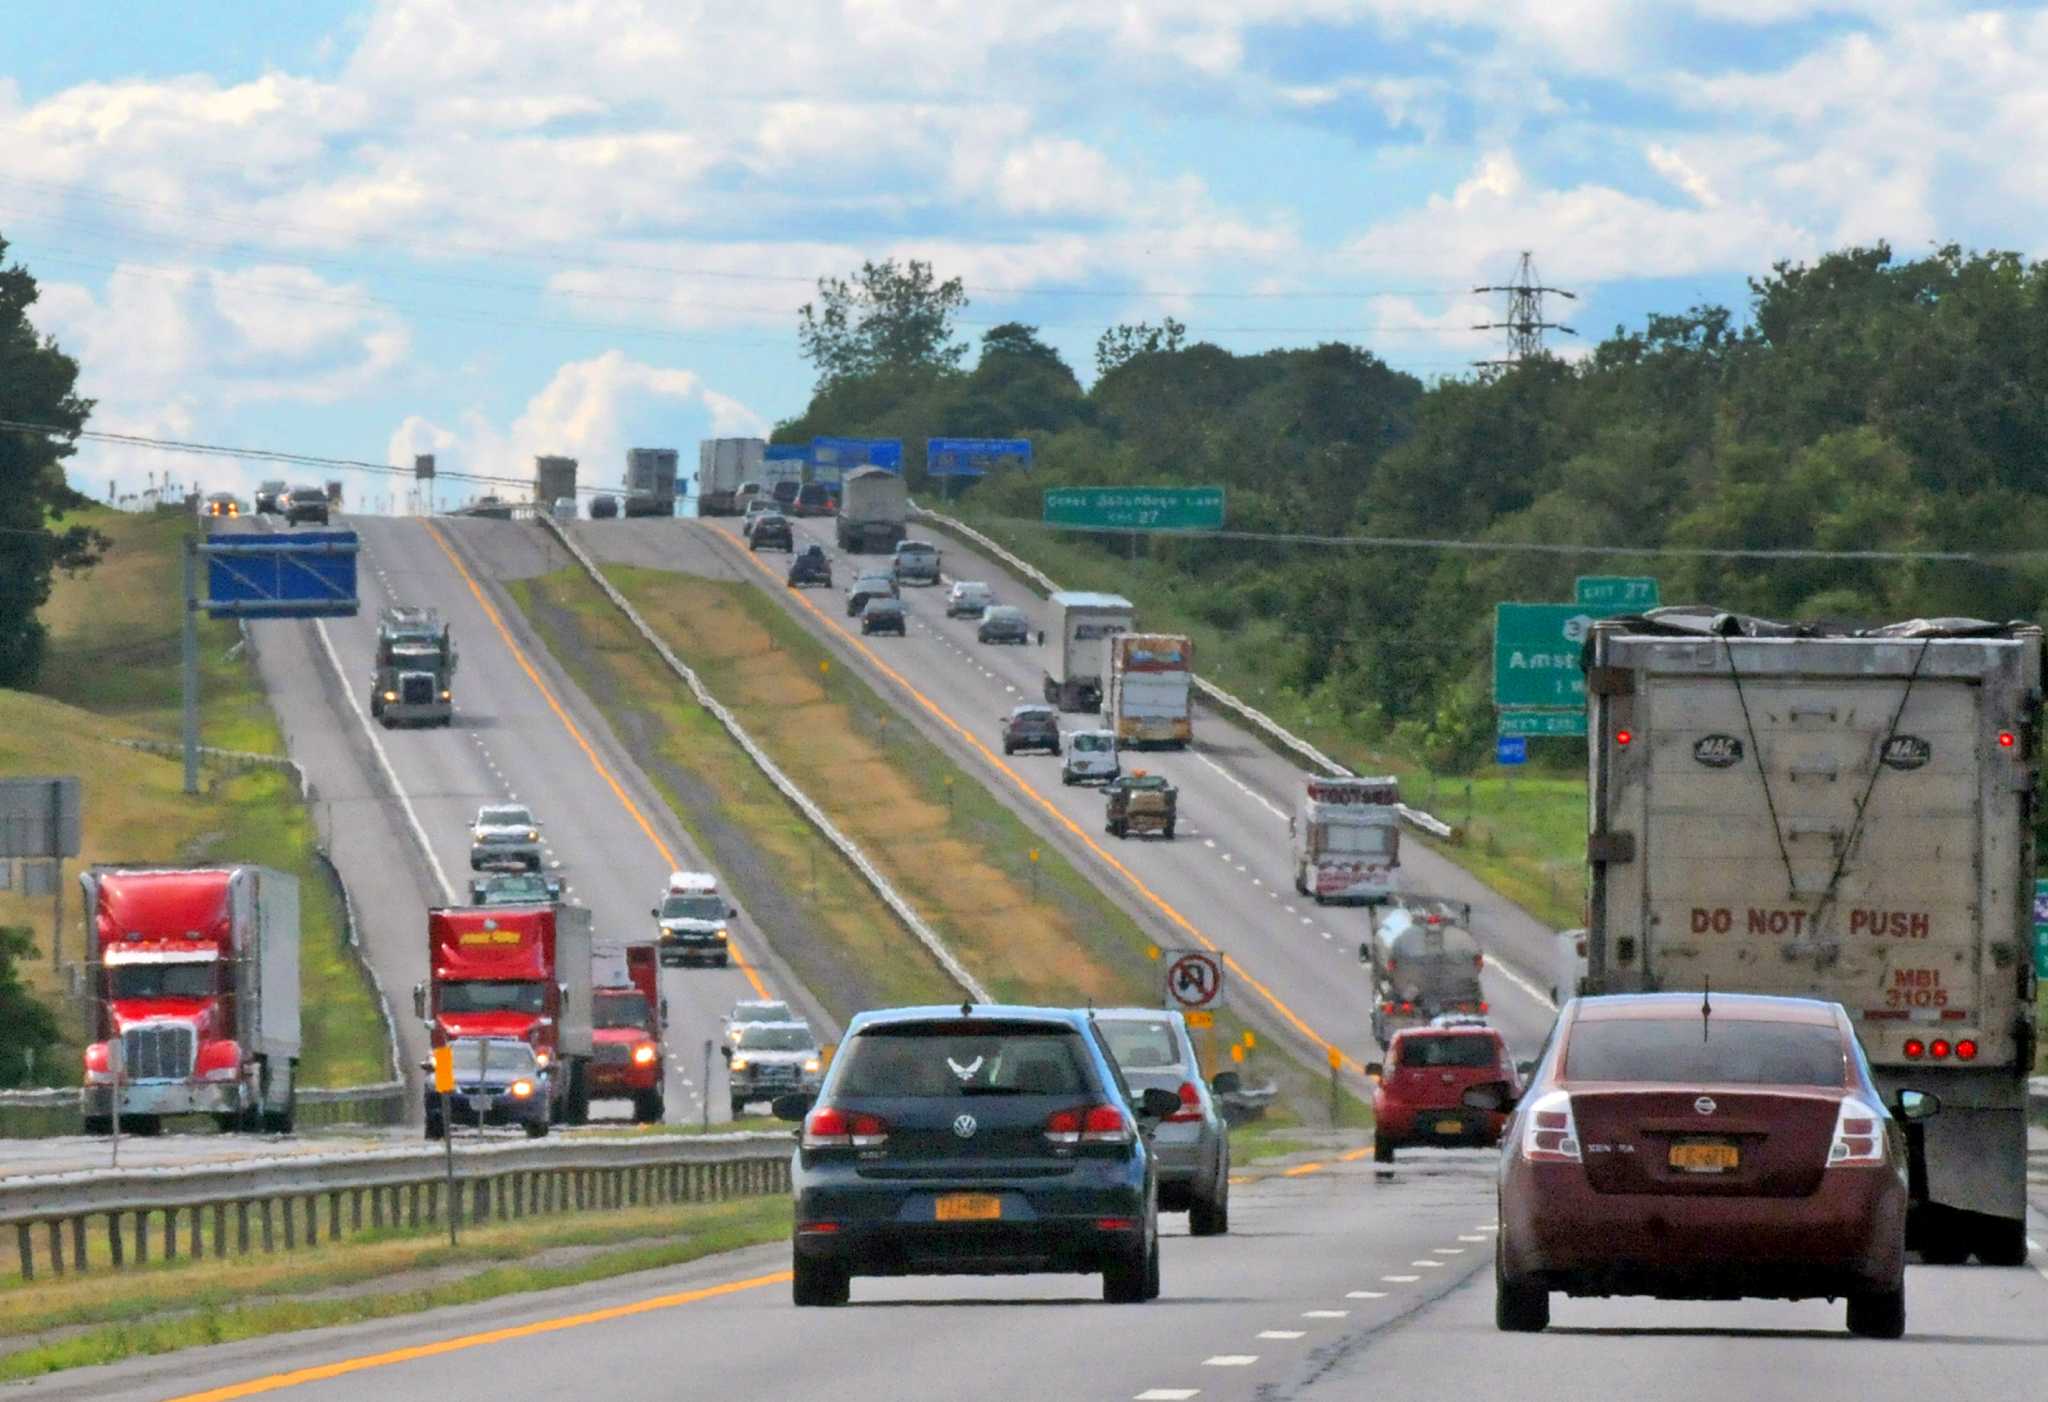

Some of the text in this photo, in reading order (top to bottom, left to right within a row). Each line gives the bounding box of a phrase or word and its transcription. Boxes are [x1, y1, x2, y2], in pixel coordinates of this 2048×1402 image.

[1509, 650, 1576, 670] Amst
[1690, 906, 1930, 938] DO NOT PUSH
